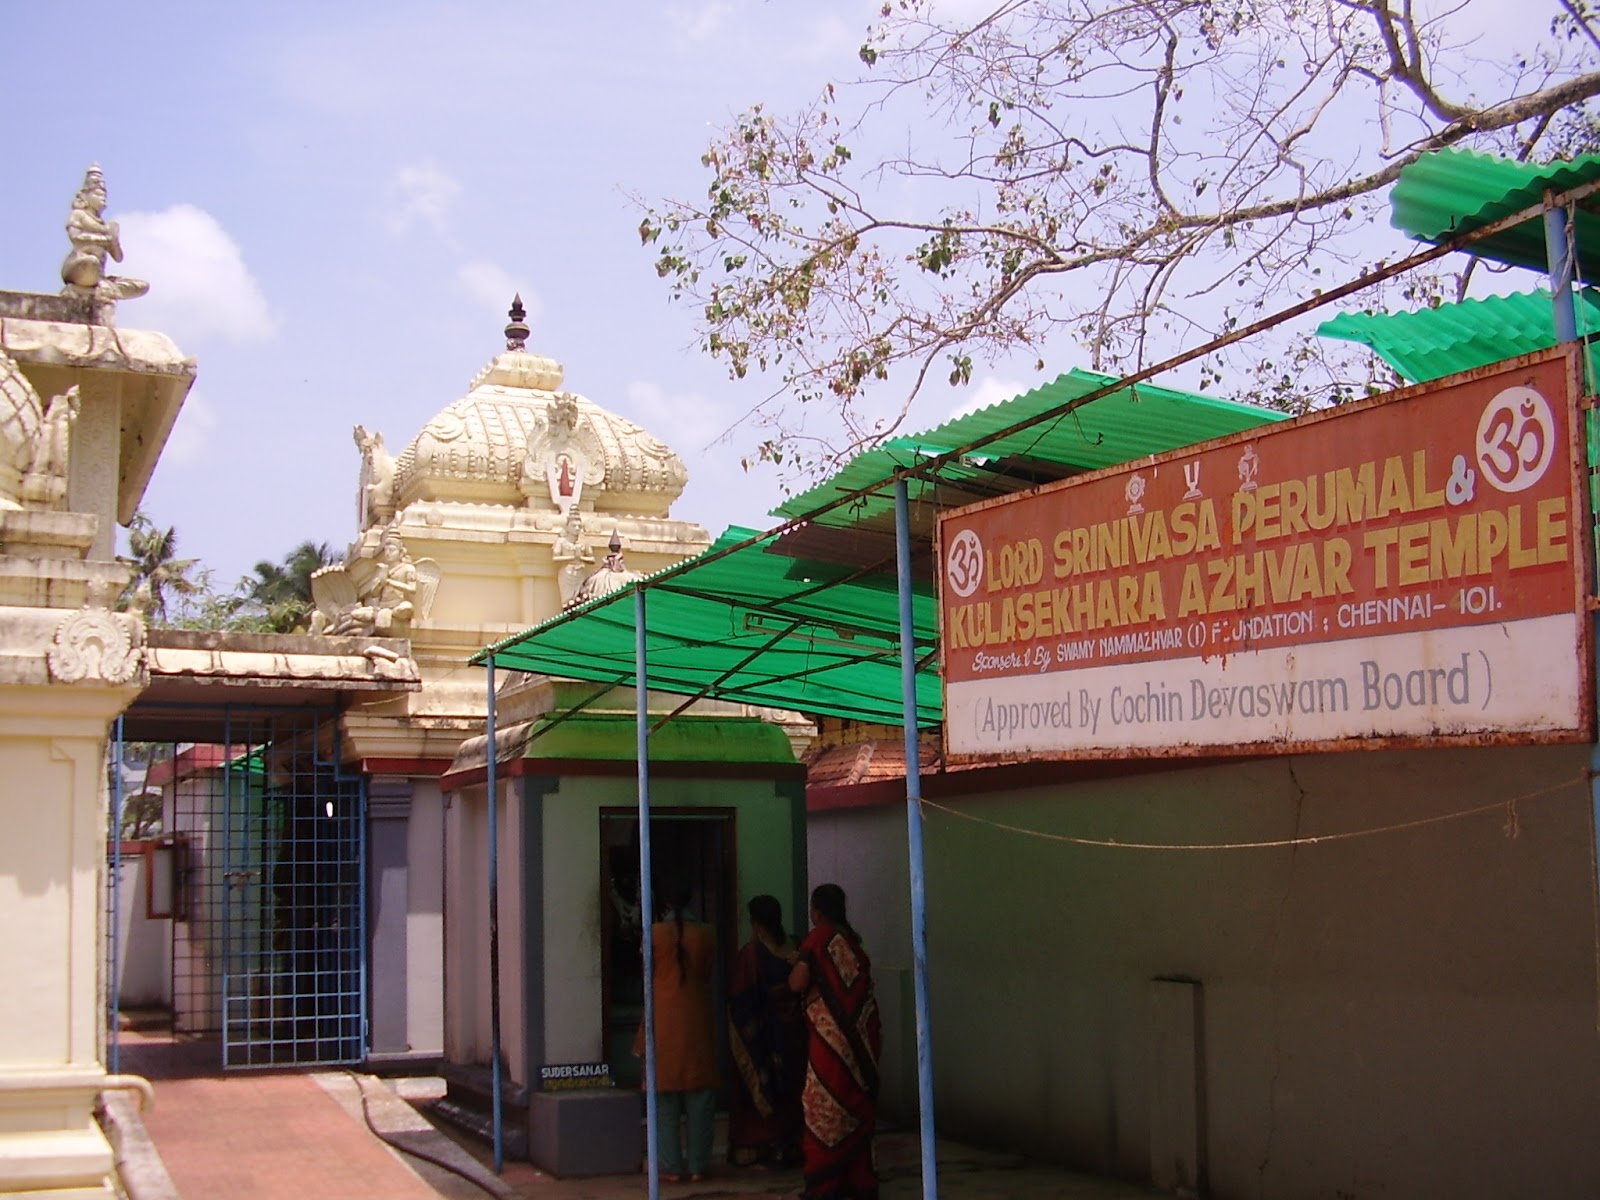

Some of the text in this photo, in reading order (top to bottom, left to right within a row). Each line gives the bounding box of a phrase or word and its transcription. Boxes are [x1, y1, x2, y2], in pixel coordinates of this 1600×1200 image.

[986, 449, 1476, 592] LORD SRINIVASA PERUMAL &
[950, 497, 1568, 650] KULASEKHARA AZHVAR TEMPLE
[1033, 645, 1051, 673] By
[1056, 639, 1096, 663] SWAMY
[1099, 627, 1183, 658] NAMMAZHVAR
[1079, 688, 1102, 735] By
[1110, 681, 1183, 725] Cochin
[1189, 672, 1349, 721] Devaswam
